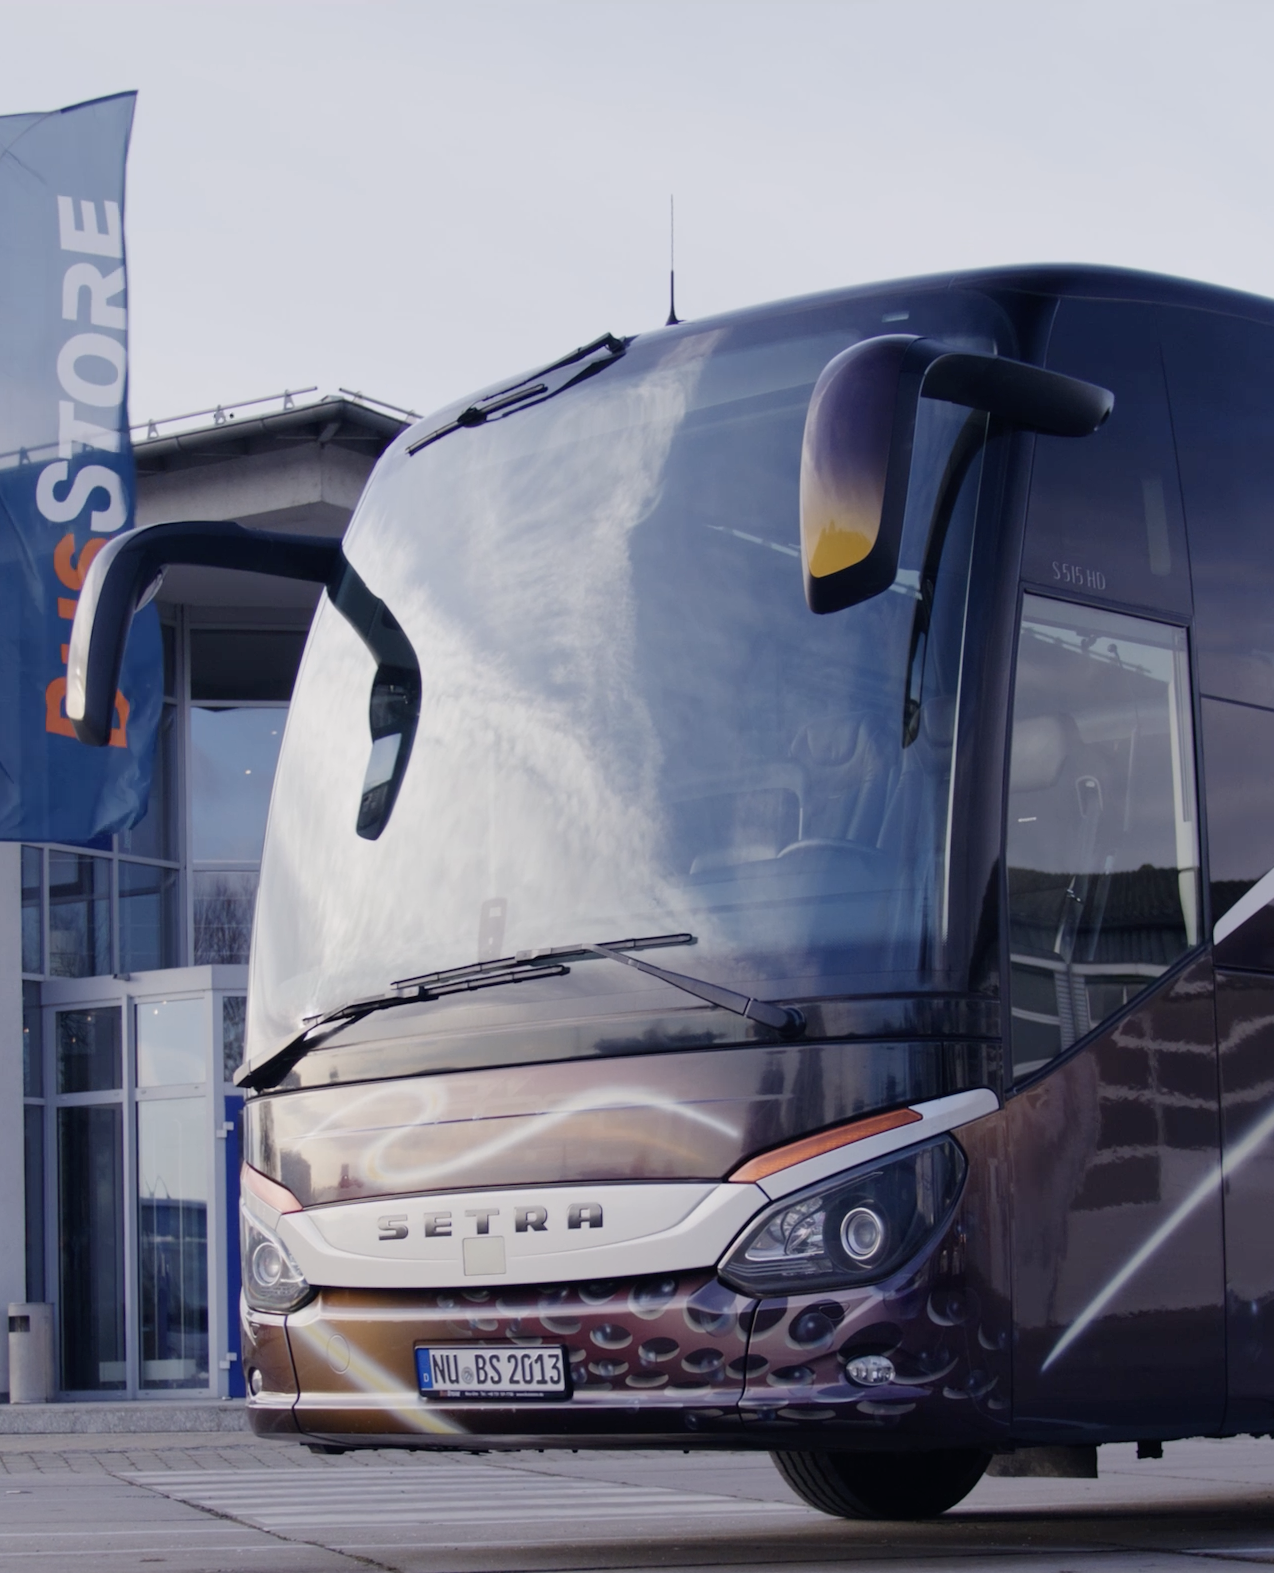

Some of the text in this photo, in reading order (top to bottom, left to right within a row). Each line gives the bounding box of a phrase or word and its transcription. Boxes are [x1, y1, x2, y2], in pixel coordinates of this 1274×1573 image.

[1086, 569, 1106, 590] HD
[377, 1202, 604, 1241] SETRA
[432, 1353, 562, 1385] NU BS 2013
